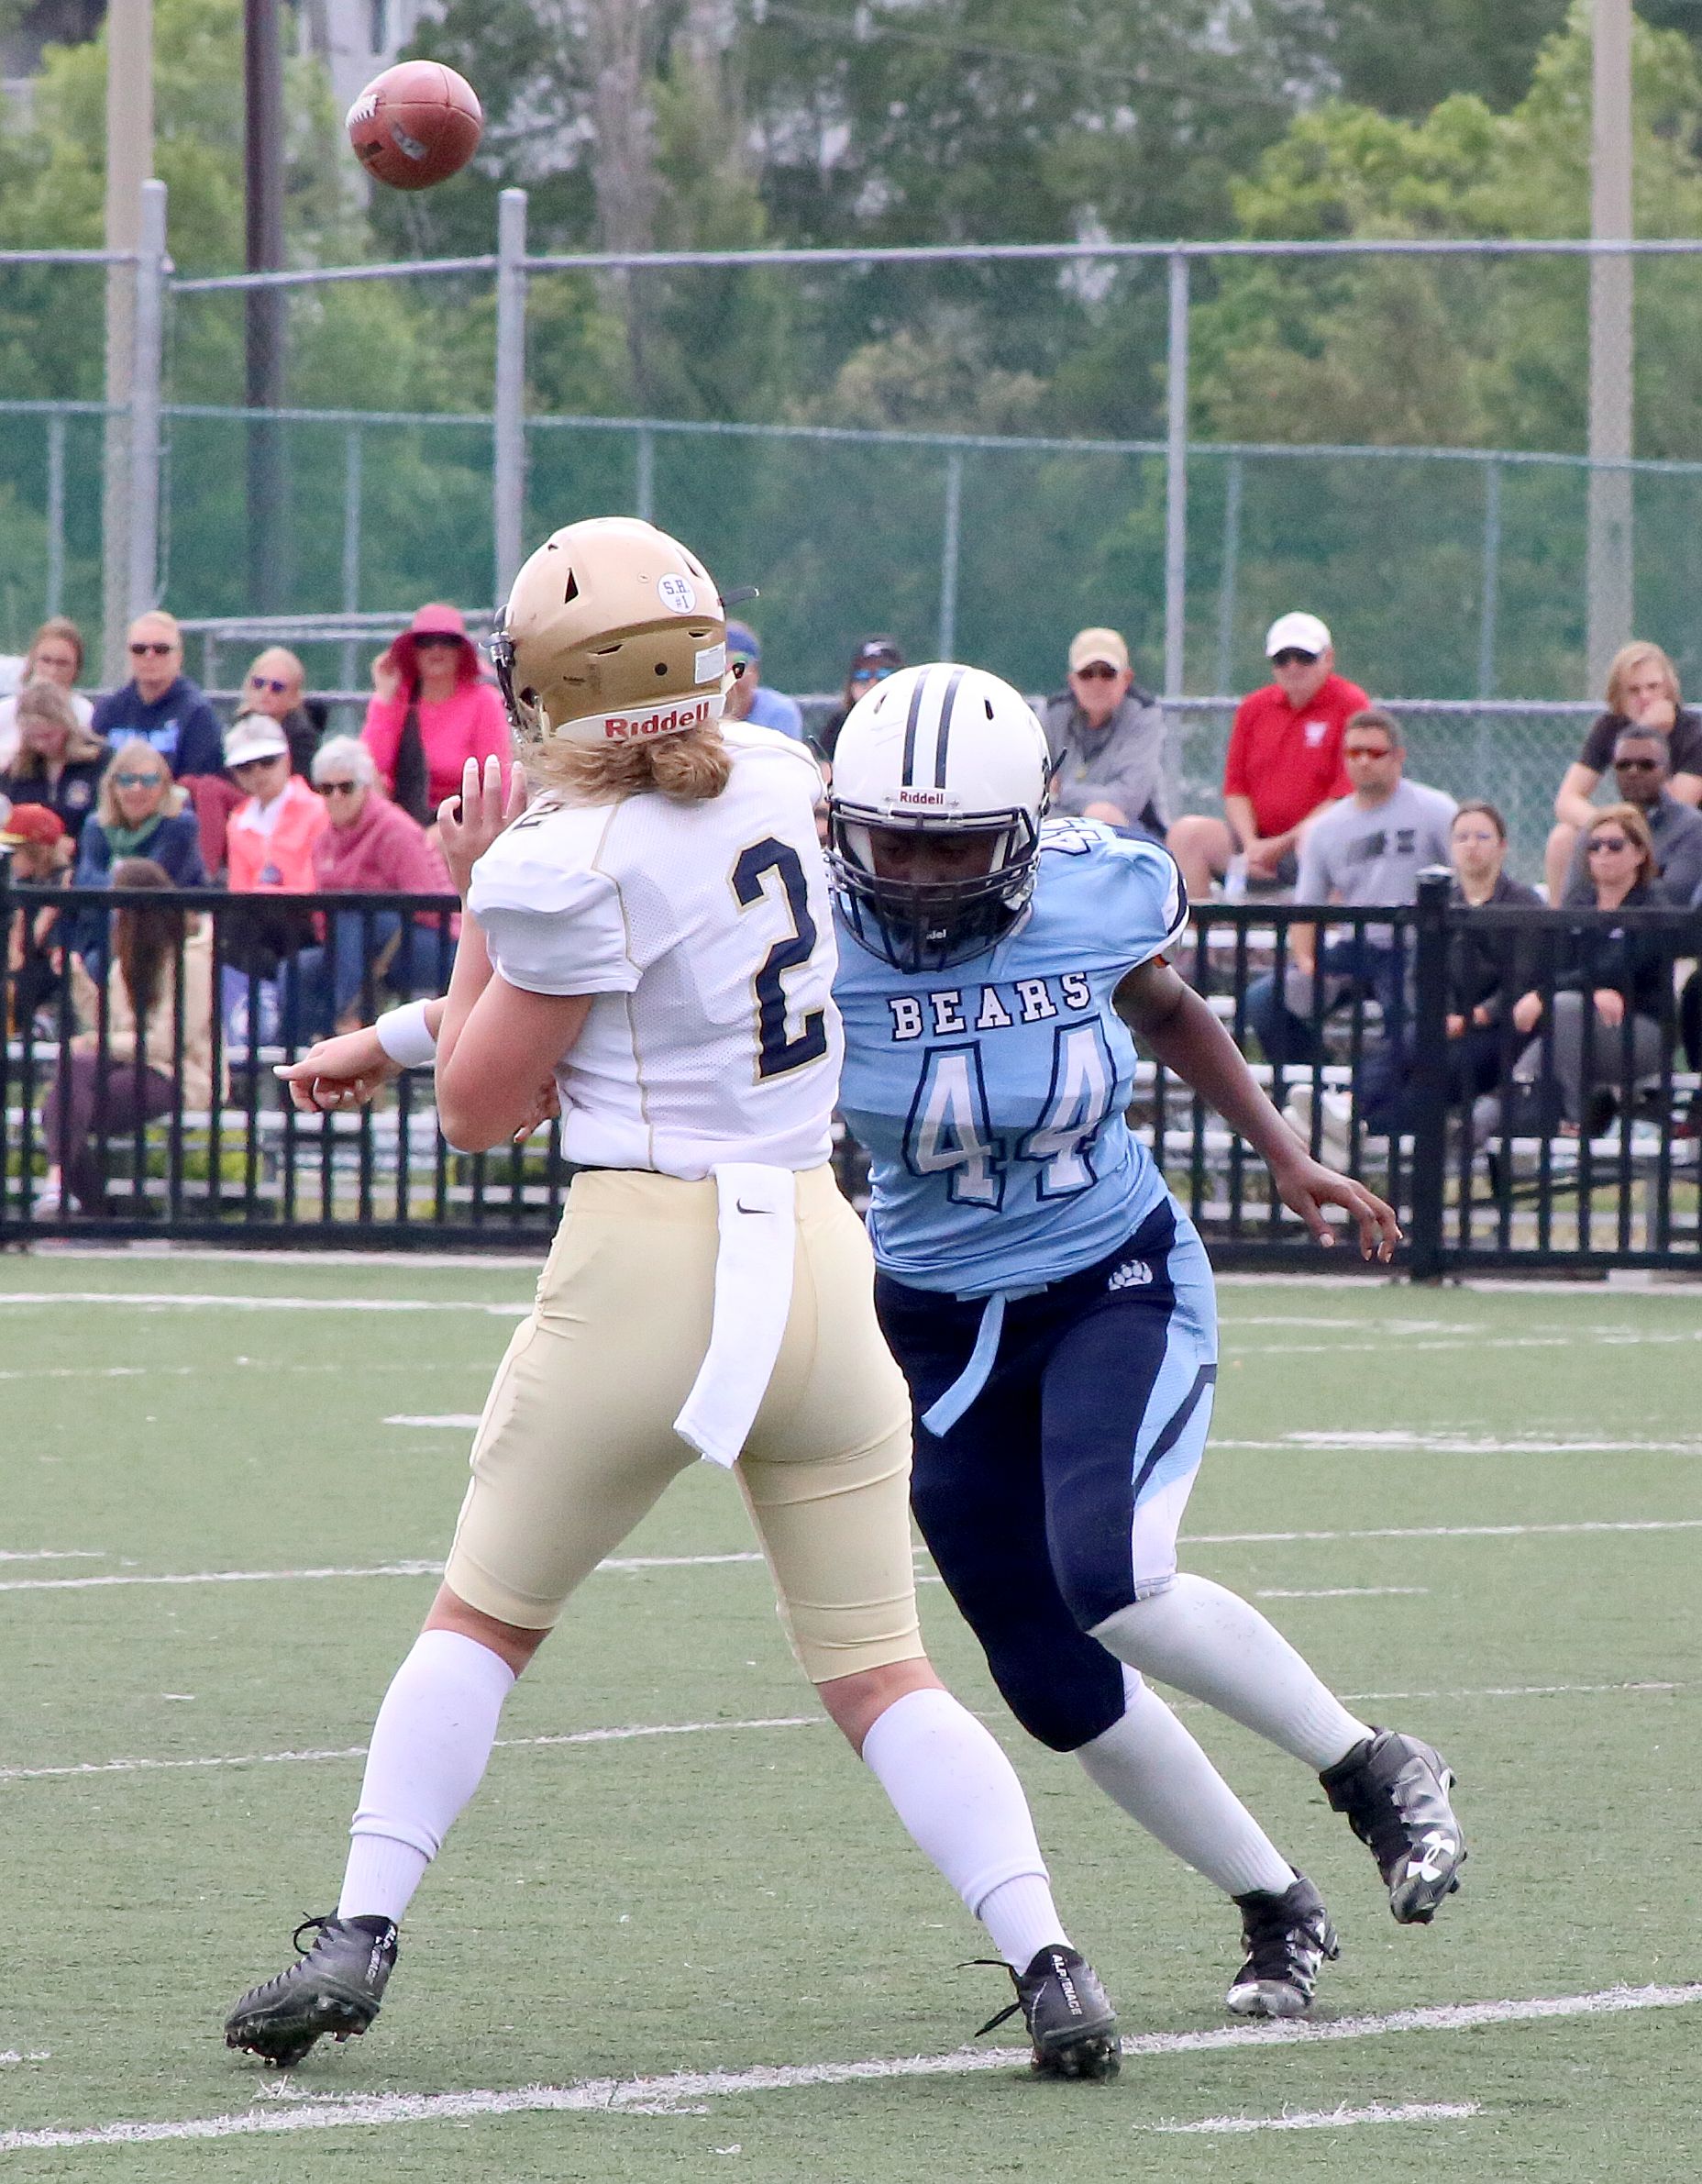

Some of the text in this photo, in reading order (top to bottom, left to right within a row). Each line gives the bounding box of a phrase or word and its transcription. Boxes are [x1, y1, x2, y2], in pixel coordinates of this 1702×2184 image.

[605, 702, 710, 737] Riddell
[900, 791, 944, 805] Riddell
[726, 833, 829, 1086] 2
[887, 971, 1091, 1042] BEARS
[902, 1013, 1118, 1214] 44
